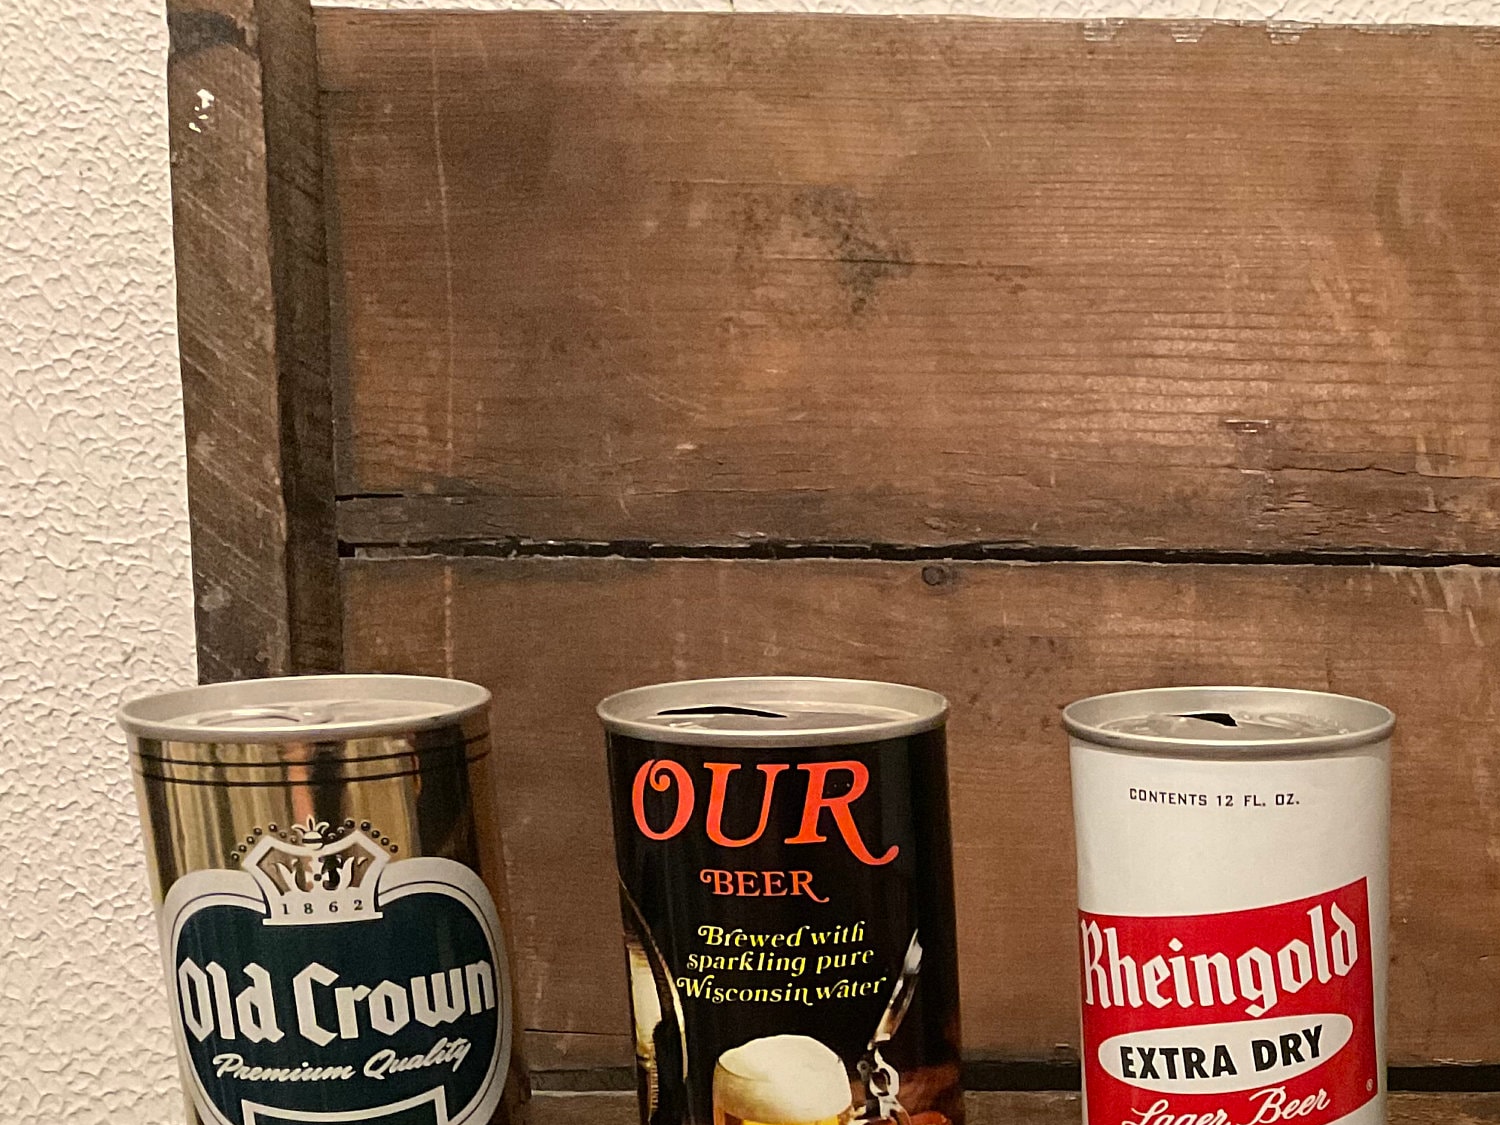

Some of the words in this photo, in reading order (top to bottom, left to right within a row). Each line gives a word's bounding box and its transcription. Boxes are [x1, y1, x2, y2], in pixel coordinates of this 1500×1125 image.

[631, 759, 900, 865] OUR
[1129, 788, 1208, 807] CONTENTS
[1216, 794, 1234, 807] 12
[1243, 793, 1267, 807] FL.
[1275, 792, 1300, 807] OZ.
[700, 869, 830, 903] BEER
[282, 898, 364, 915] 1862
[698, 925, 810, 947] Brewed
[811, 921, 865, 945] with
[687, 951, 806, 977] sparkling
[816, 949, 874, 975] pure
[1081, 902, 1359, 1018] Rheingold
[178, 957, 284, 1043] Old
[295, 959, 496, 1047] Crown
[676, 974, 814, 1006] Wisconsin
[816, 977, 887, 1000] water
[213, 1053, 356, 1083] Premium
[362, 1037, 473, 1080] Quality
[1119, 1045, 1238, 1080] EXTRA
[1251, 1024, 1322, 1071] DRY
